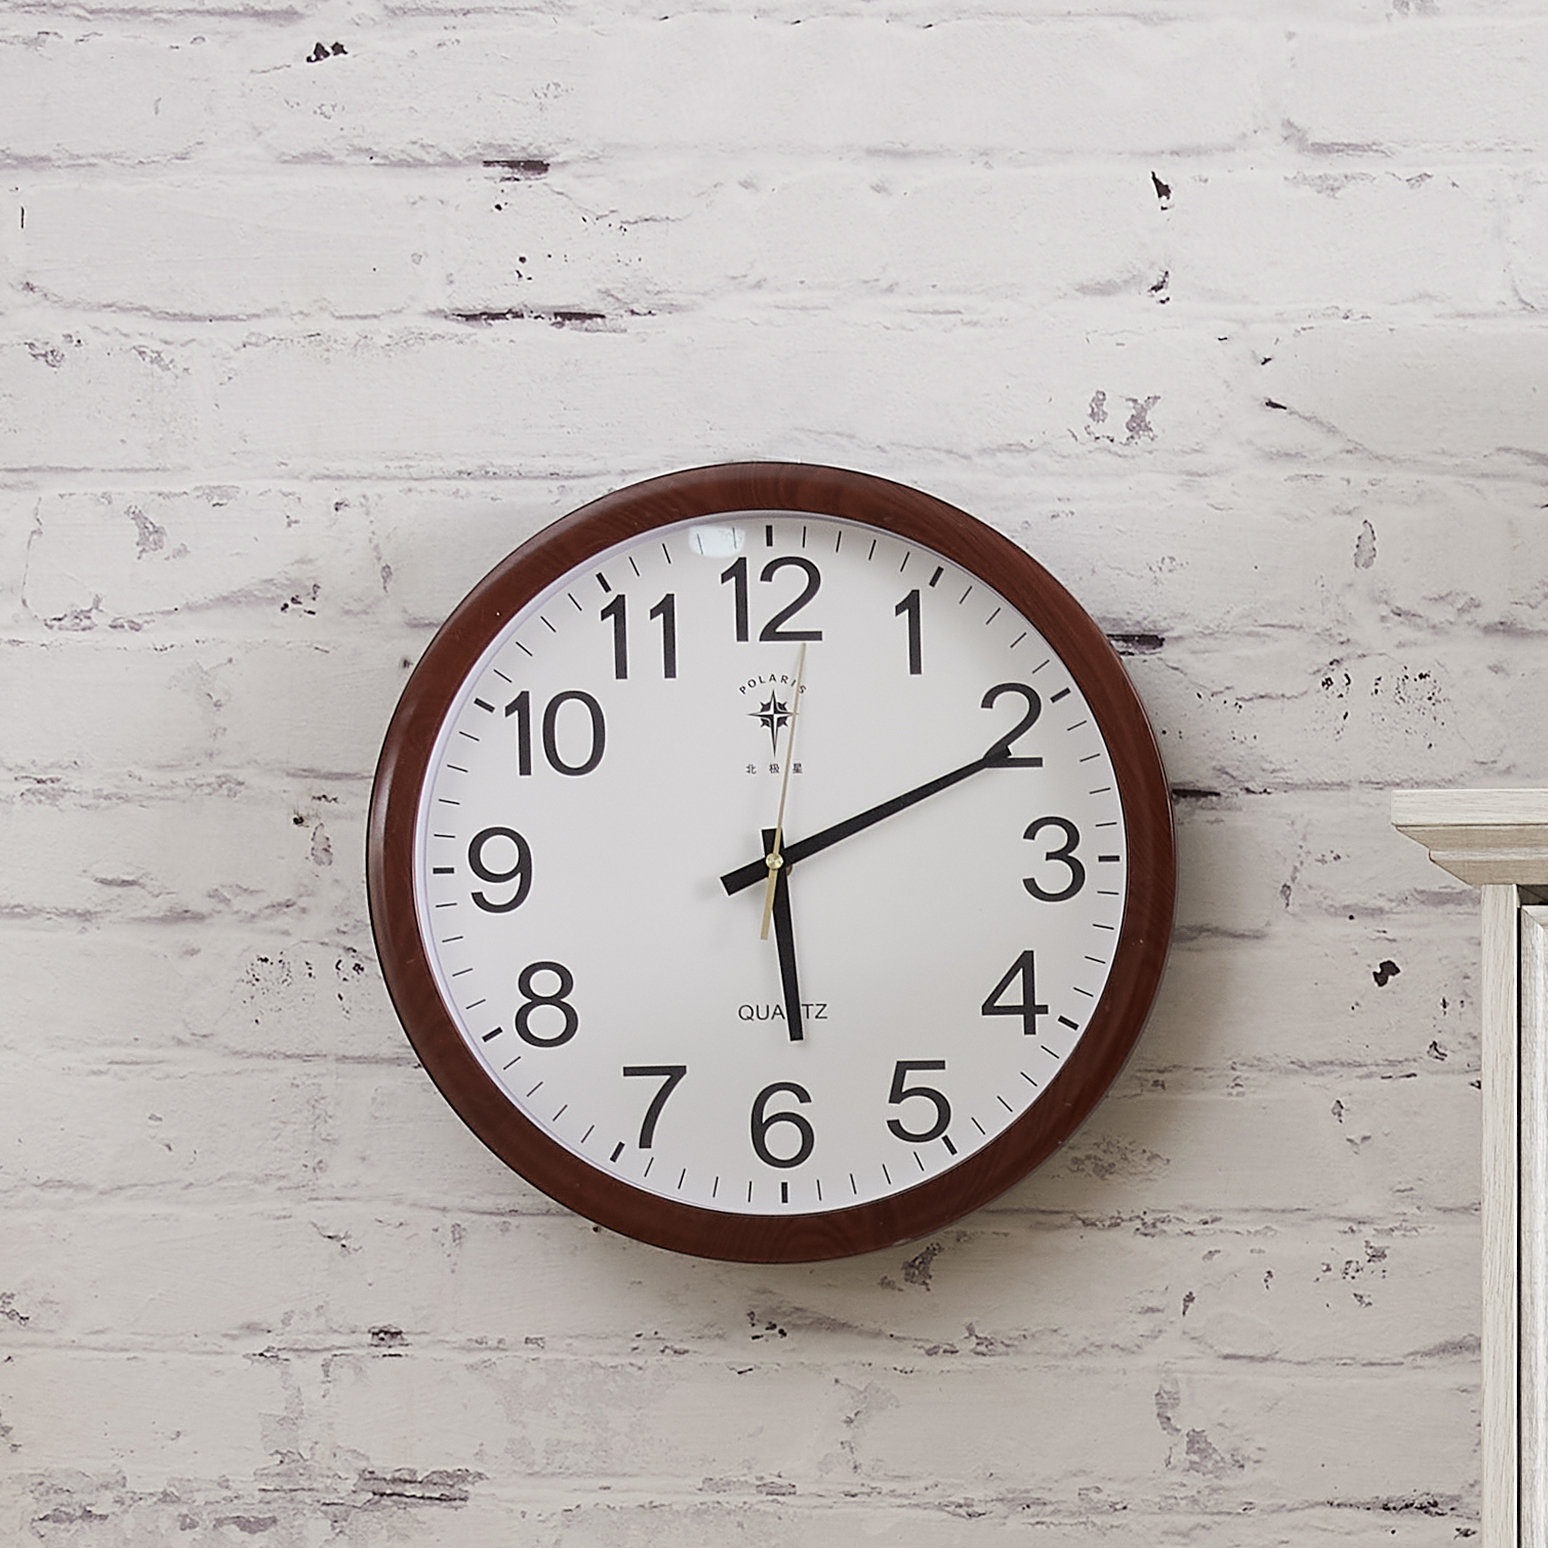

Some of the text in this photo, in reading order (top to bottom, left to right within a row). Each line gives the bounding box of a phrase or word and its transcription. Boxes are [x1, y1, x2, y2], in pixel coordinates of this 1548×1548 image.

[601, 592, 676, 679] 11
[721, 556, 822, 641] 12
[895, 589, 921, 674] 1
[739, 674, 806, 695] POLARIS
[979, 681, 1043, 768] 2
[505, 691, 605, 776] 10
[746, 763, 802, 774] 北极星
[468, 827, 532, 913] 9
[1023, 817, 1085, 902] 3
[515, 962, 578, 1047] 8
[738, 1003, 828, 1021] QUATZ
[982, 950, 1048, 1035] 4
[620, 1065, 686, 1151] 7
[751, 1082, 814, 1168] 6
[885, 1059, 952, 1144] 5
